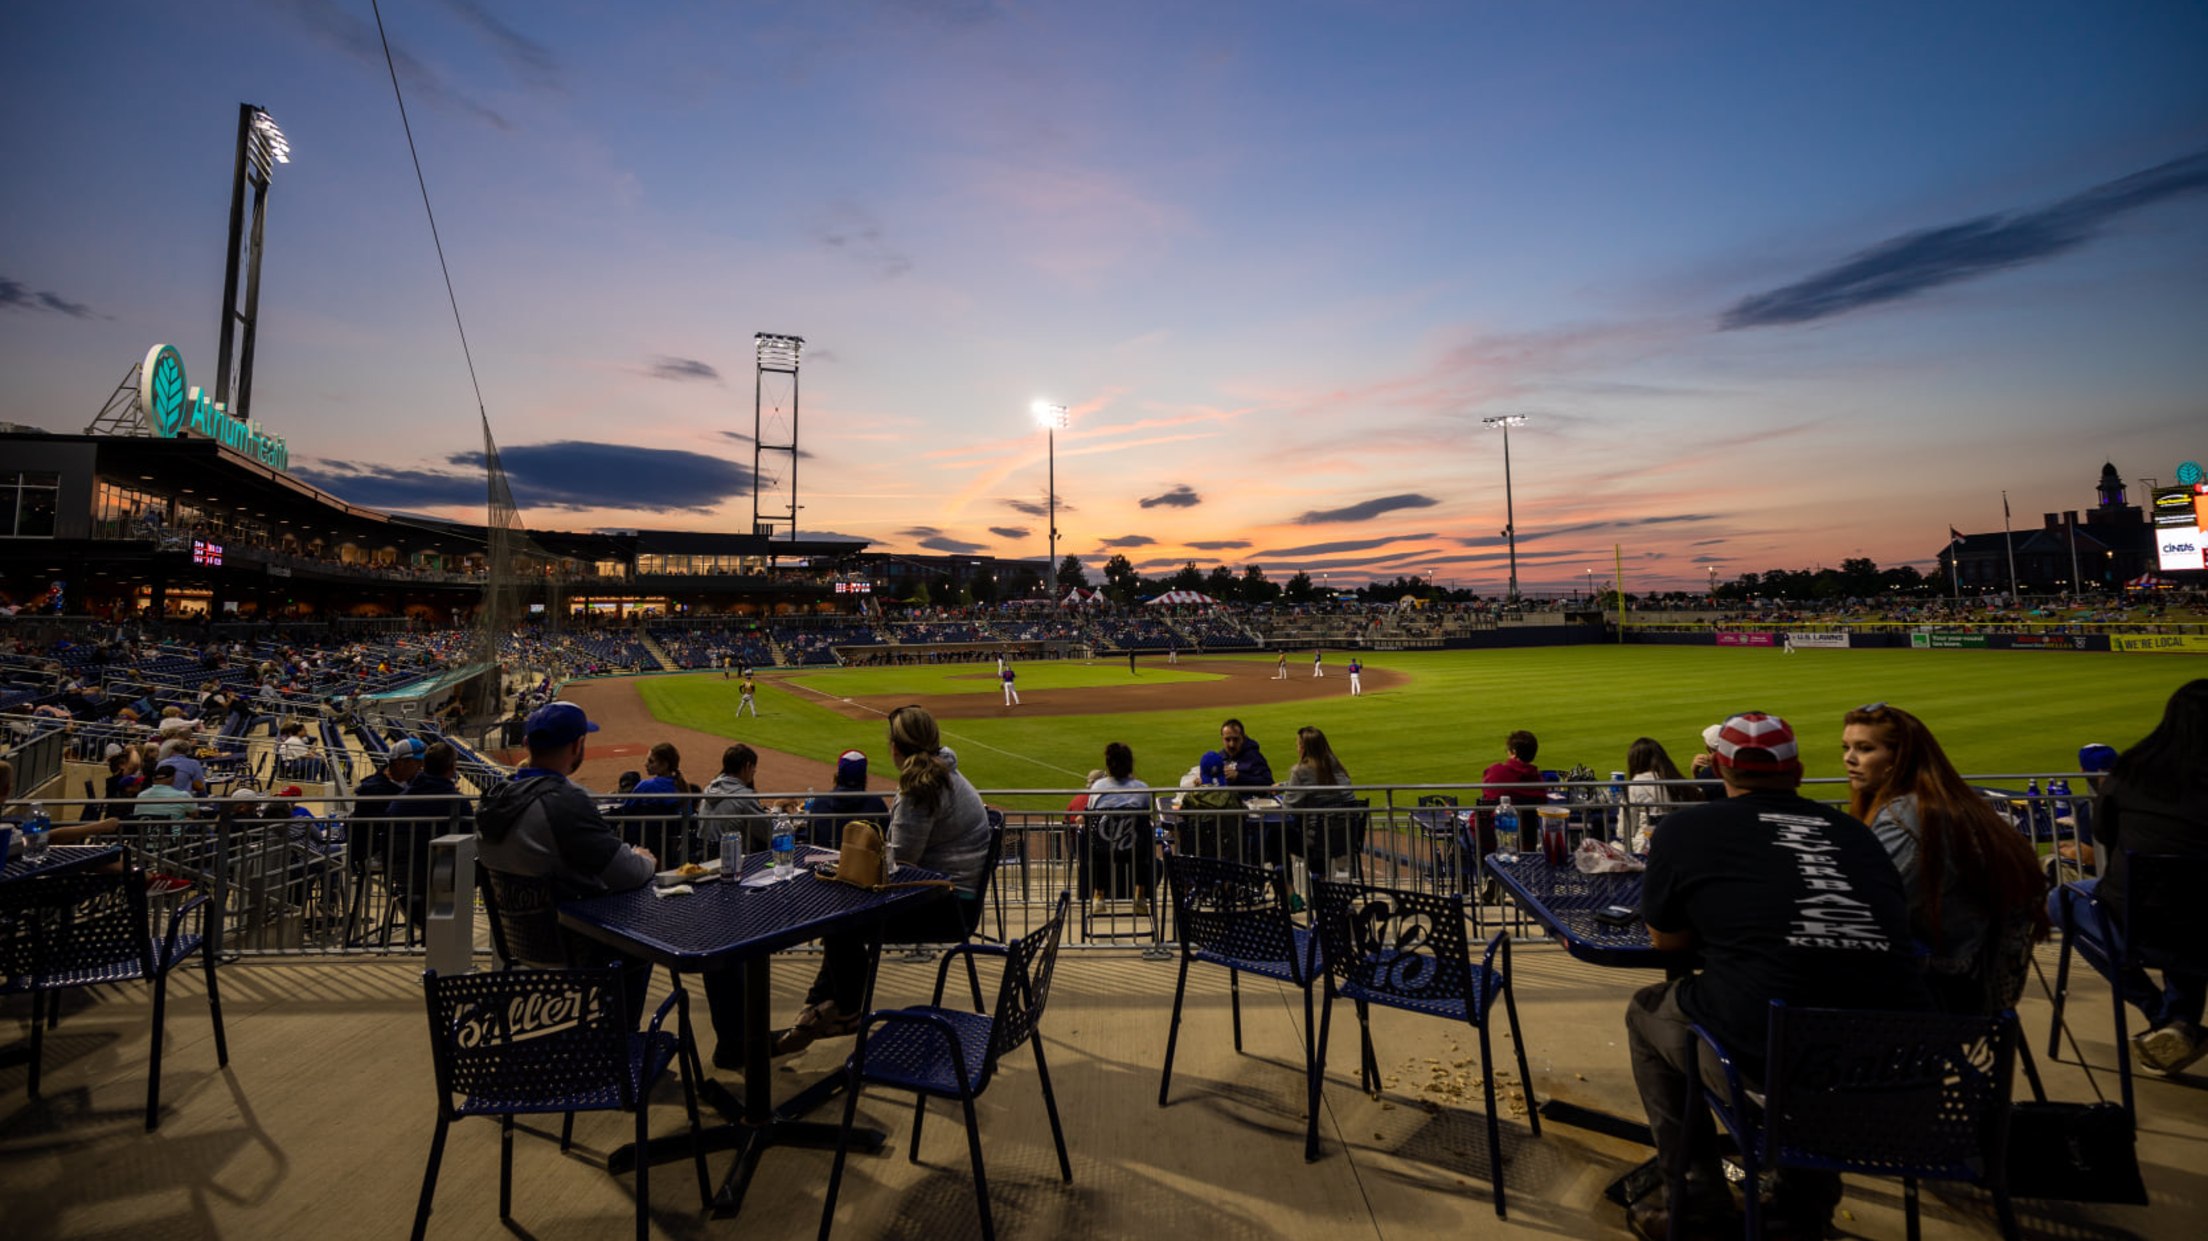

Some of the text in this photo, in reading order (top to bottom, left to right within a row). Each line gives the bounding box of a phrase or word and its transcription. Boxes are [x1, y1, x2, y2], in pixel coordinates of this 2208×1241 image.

[189, 386, 289, 472] Atrium Health
[2155, 636, 2185, 648] LOCAL
[1785, 936, 1890, 952] KREW
